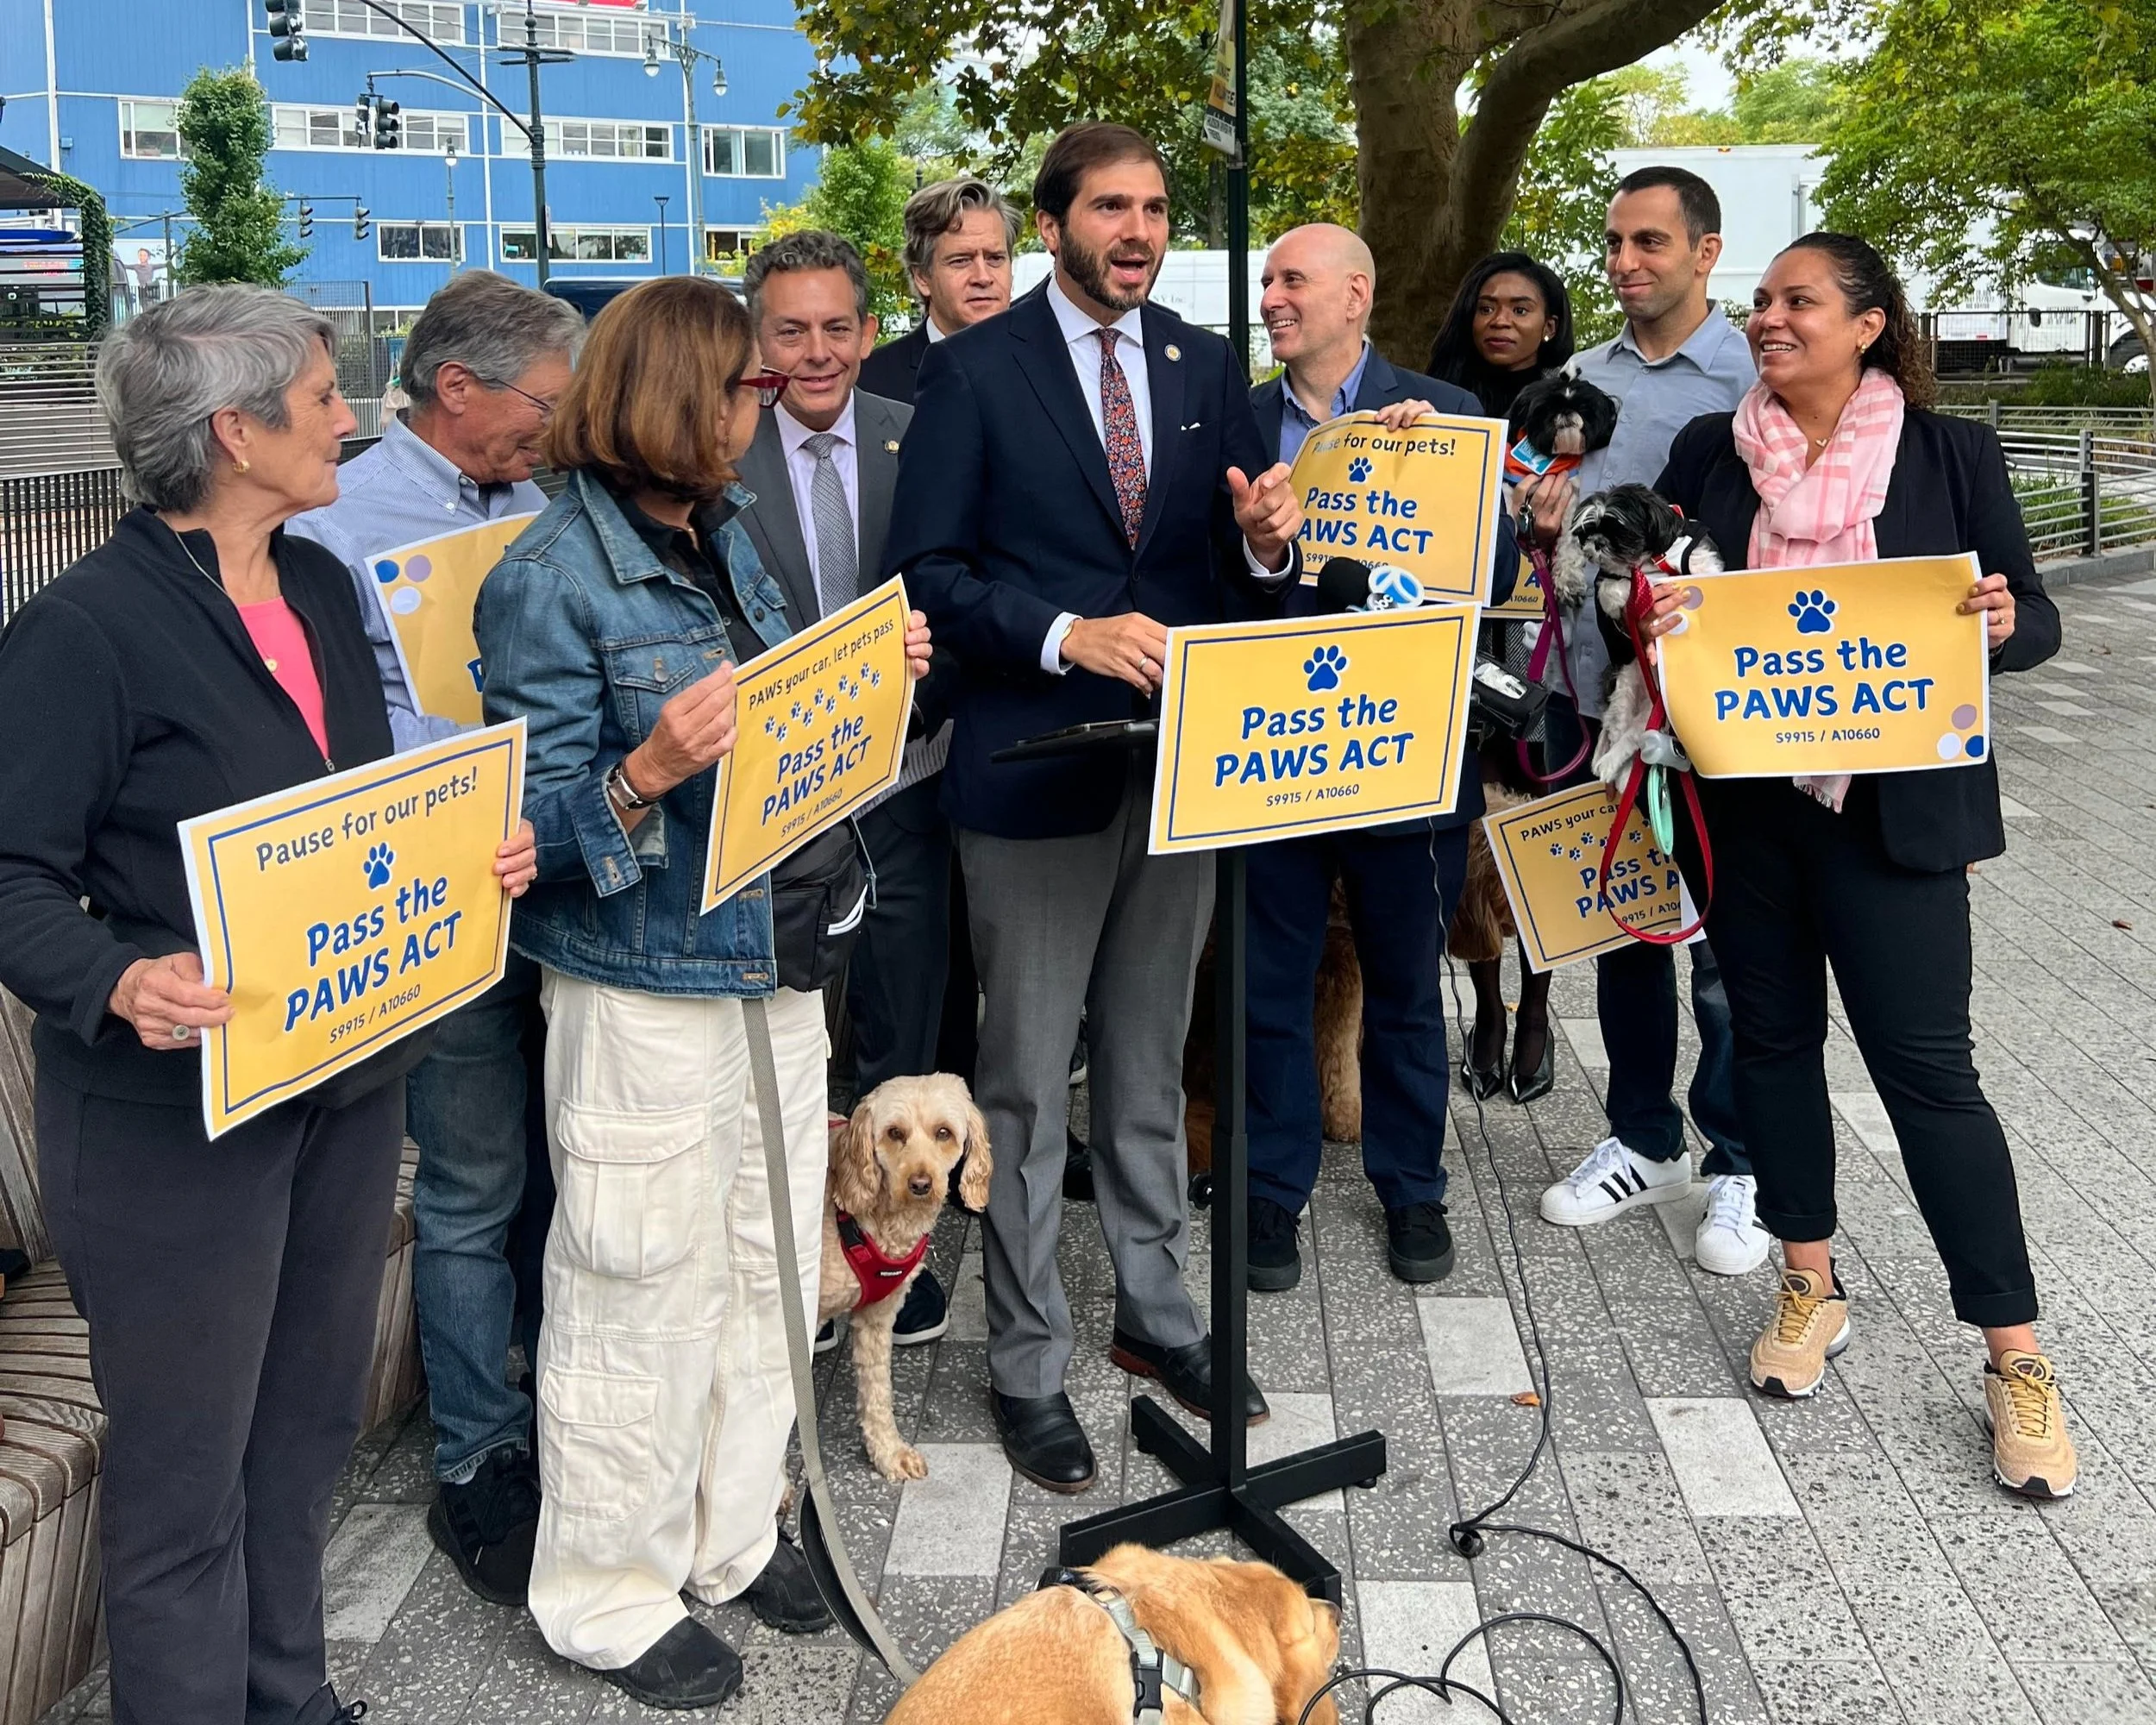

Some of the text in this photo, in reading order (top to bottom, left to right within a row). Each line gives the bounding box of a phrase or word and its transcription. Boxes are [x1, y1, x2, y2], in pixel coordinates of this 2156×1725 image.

[1344, 432, 1367, 448] for
[1372, 438, 1402, 452] our
[1405, 439, 1455, 456] pets!
[1305, 486, 1417, 518] Pass the
[1297, 518, 1433, 555] AWS ACT
[749, 680, 783, 711] PAWS
[786, 667, 810, 693] your
[834, 643, 848, 662] let
[850, 632, 871, 659] pets
[874, 618, 893, 645] pass
[1734, 637, 1907, 678] Pass the
[1242, 693, 1398, 739] Pass the
[1714, 678, 1934, 721] PAWS ACT
[777, 715, 864, 784] Pass the
[1776, 731, 1814, 743] S9915
[1832, 727, 1880, 741] A10660
[761, 735, 872, 825] PAWS ACT
[1215, 732, 1414, 787] PAWS ACT
[781, 813, 805, 837] S9915
[813, 788, 843, 815] A10660
[1266, 792, 1302, 807] S9915
[1315, 784, 1360, 800] A10660
[256, 766, 478, 871] Pause for our pets!
[1520, 818, 1563, 841] PAWS
[1565, 809, 1595, 829] your
[1576, 875, 1658, 918] PAWS
[1622, 910, 1646, 925] 9915
[1658, 900, 1681, 913] A10
[307, 876, 448, 967] Pass the
[285, 911, 463, 1032] PAWS ACT
[329, 1013, 366, 1044] S9915
[379, 984, 421, 1018] A10660
